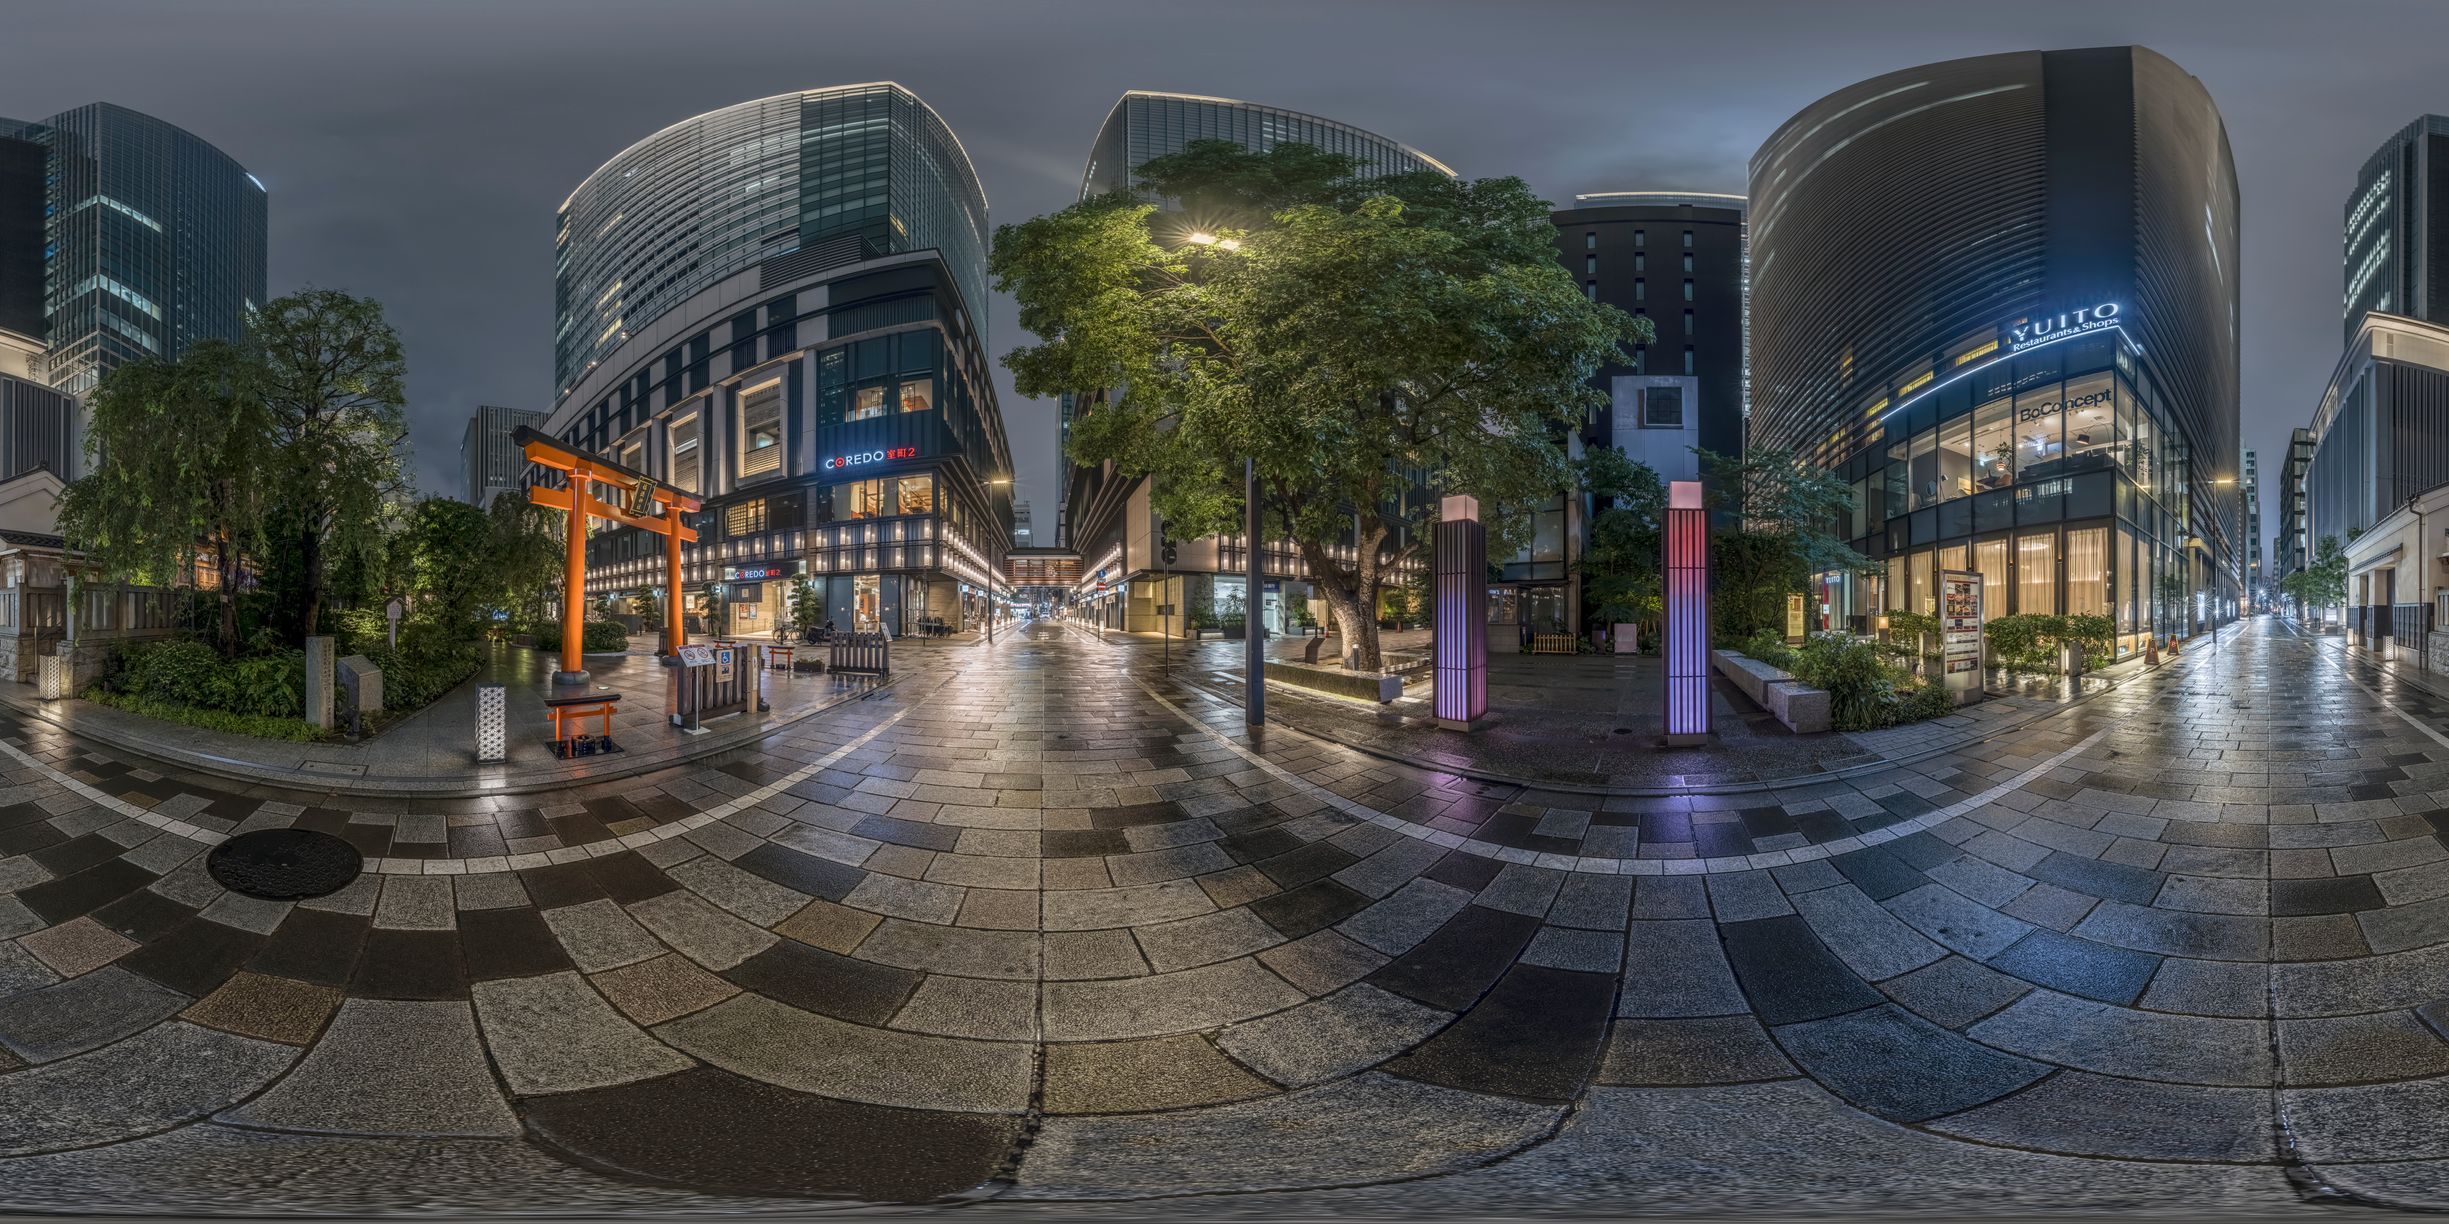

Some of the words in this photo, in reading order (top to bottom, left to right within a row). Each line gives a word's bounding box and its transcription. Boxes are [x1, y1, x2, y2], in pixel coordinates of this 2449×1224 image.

[2013, 303, 2119, 341] YUITO
[2013, 328, 2072, 352] Restaurants
[2082, 317, 2119, 331] Shops
[2020, 388, 2111, 421] BoConcept
[825, 451, 884, 469] COREDO
[735, 570, 765, 579] COREDO
